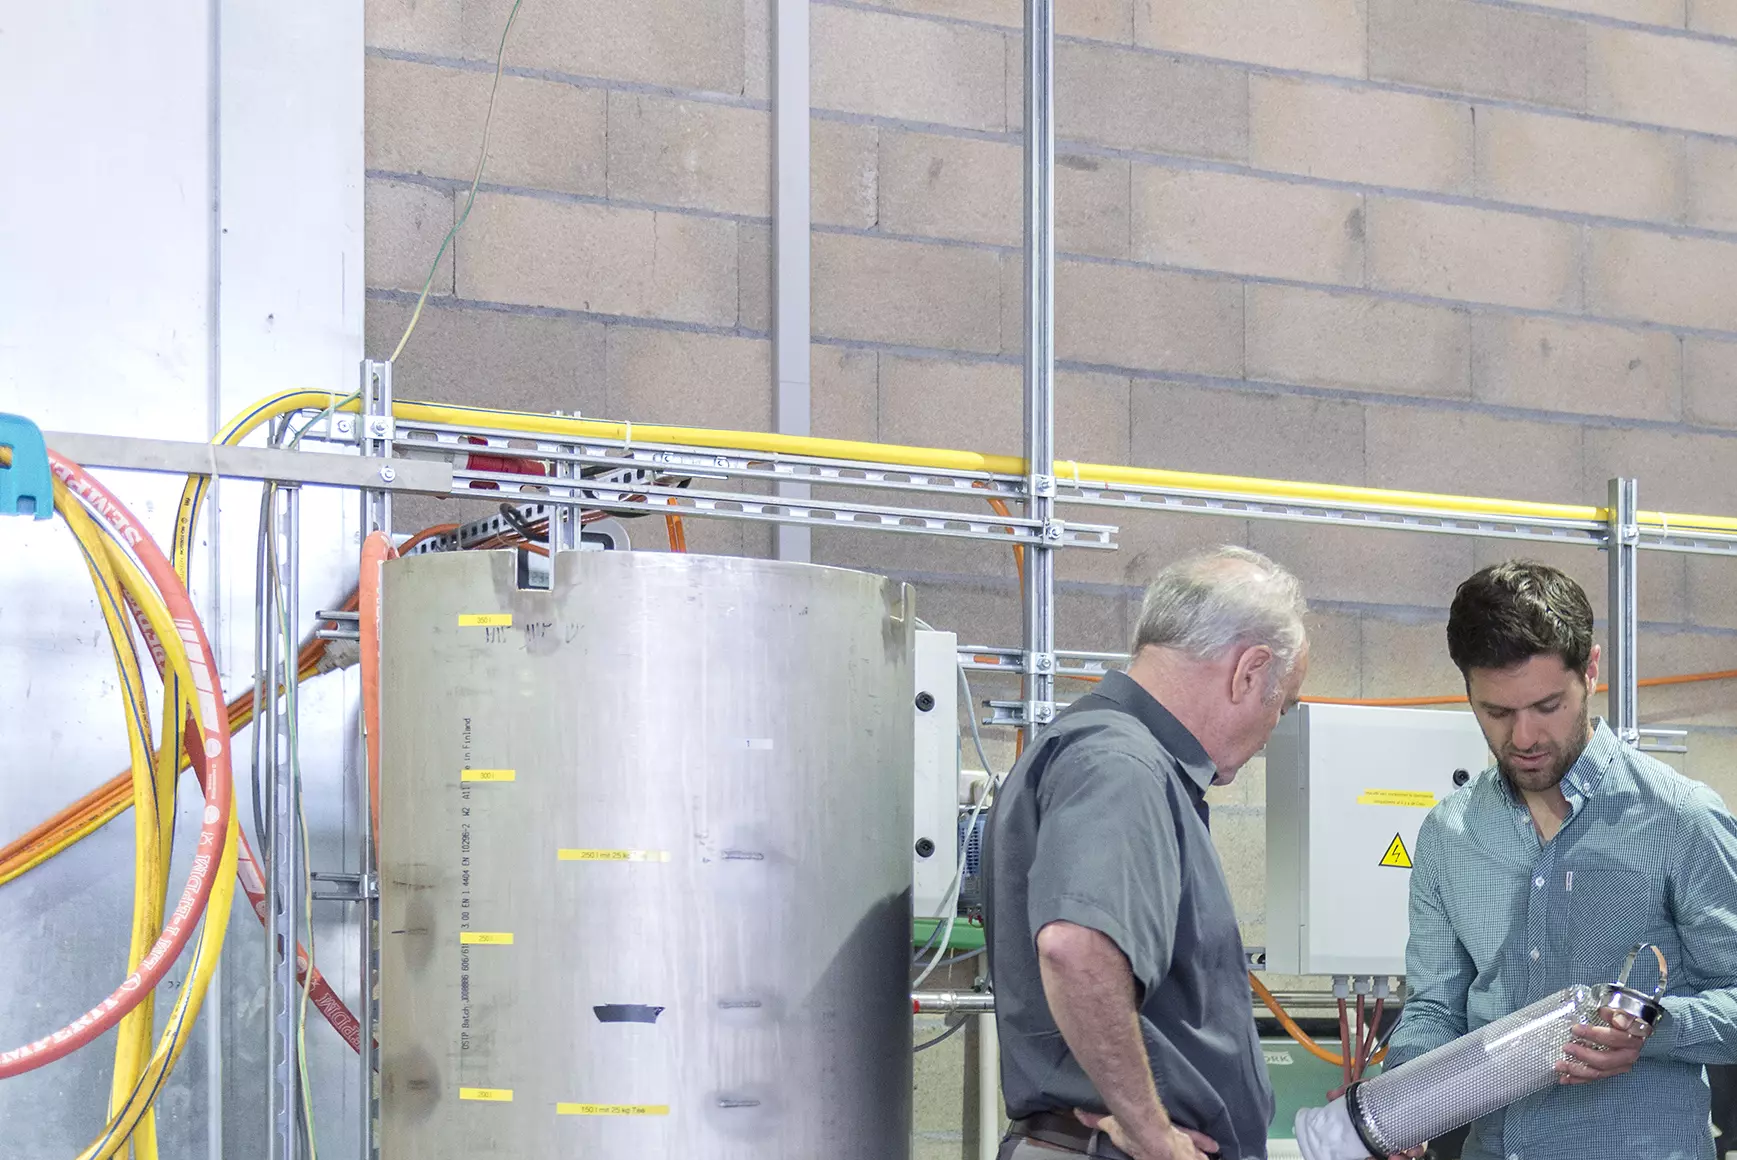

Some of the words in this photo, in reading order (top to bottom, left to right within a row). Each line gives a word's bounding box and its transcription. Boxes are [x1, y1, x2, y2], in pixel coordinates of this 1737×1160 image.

[462, 718, 471, 749] Finland
[462, 857, 471, 867] EN
[461, 898, 470, 908] EN
[461, 1032, 470, 1050] OSTP
